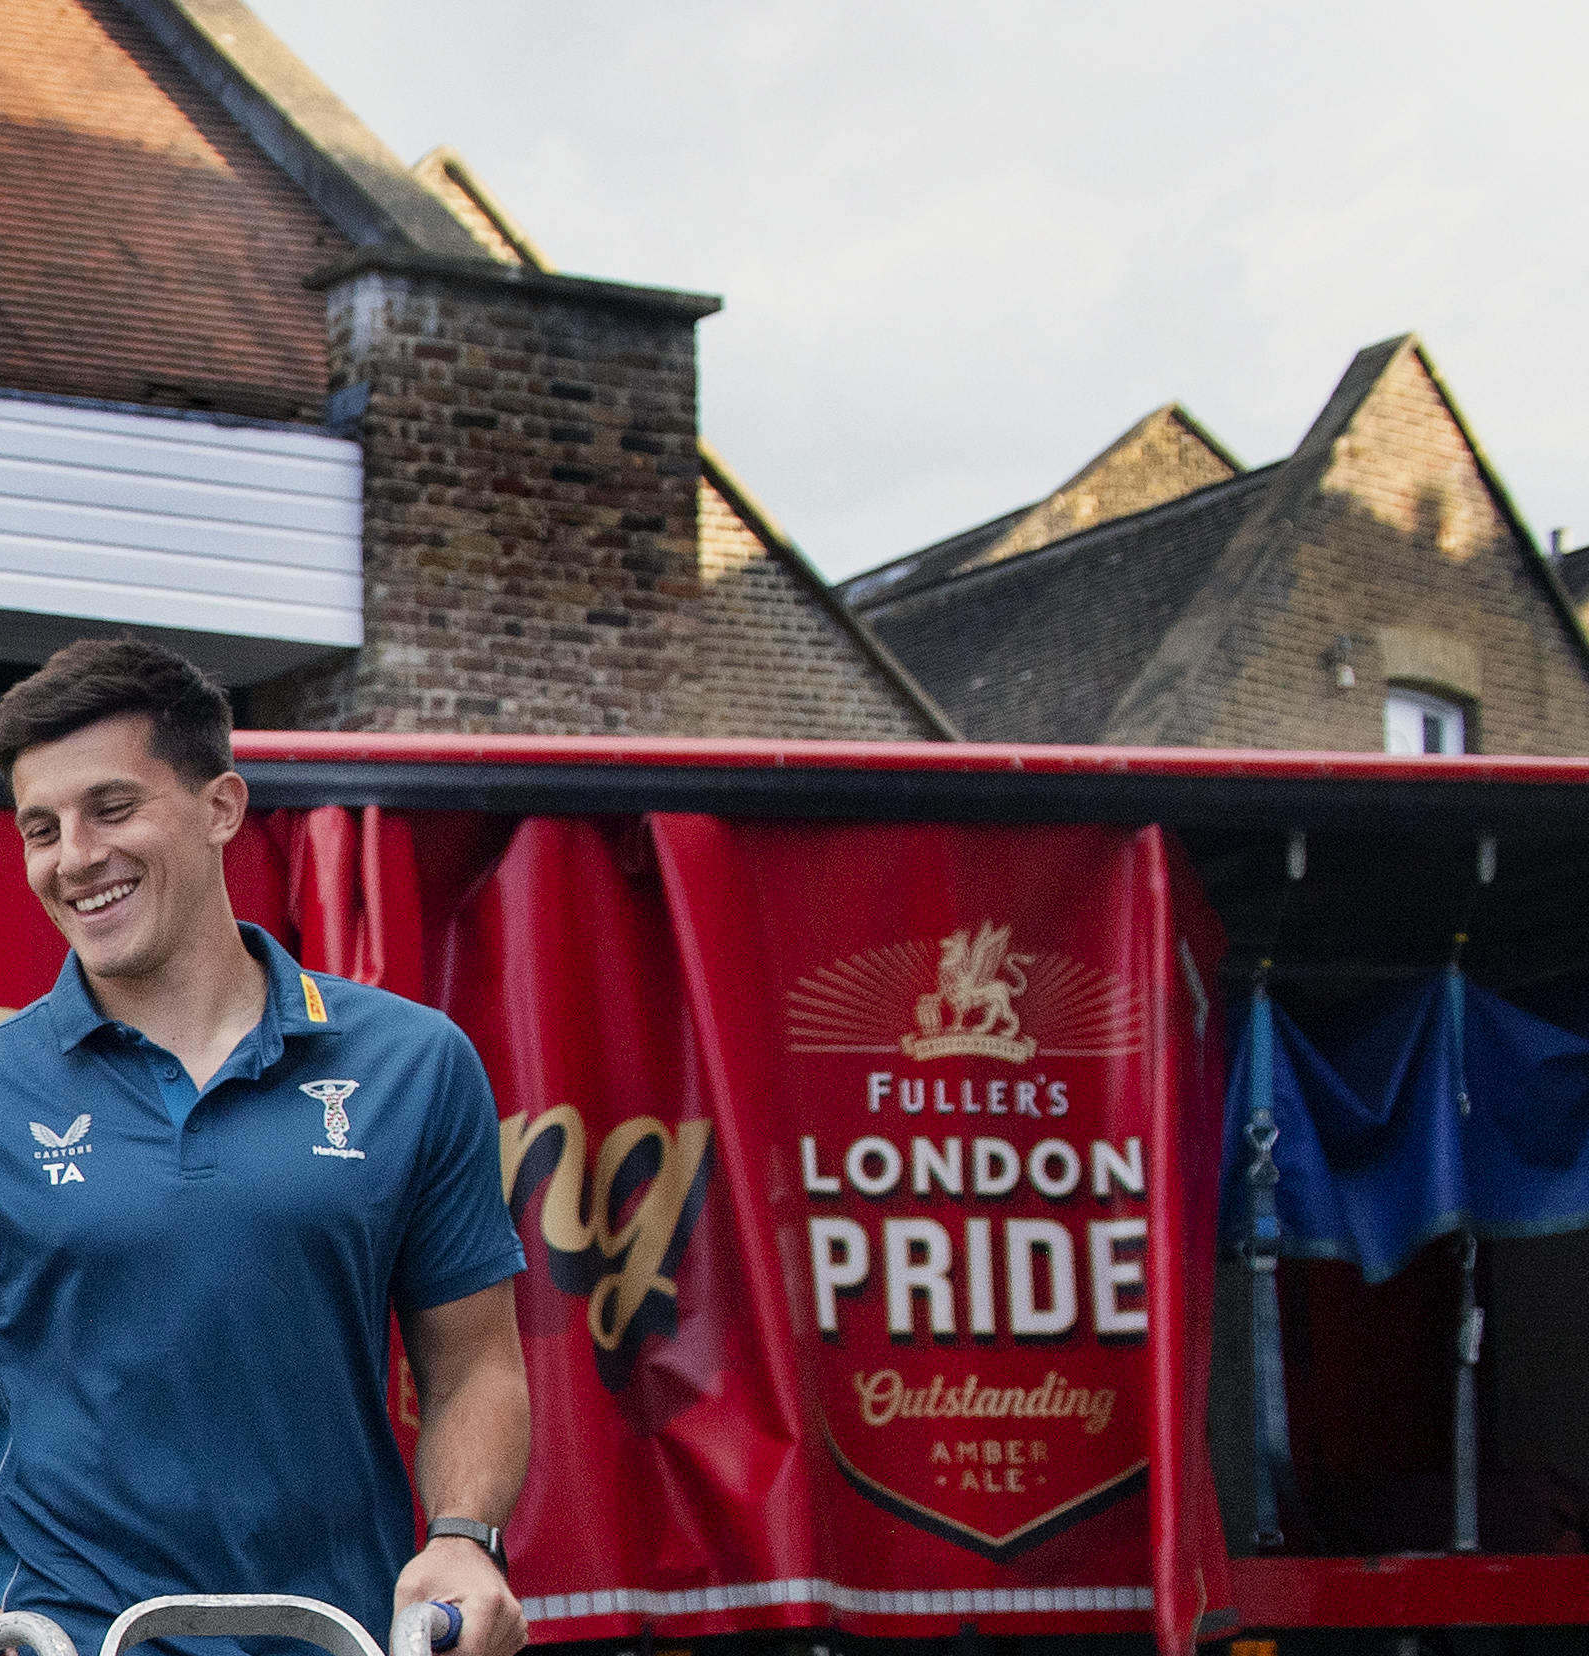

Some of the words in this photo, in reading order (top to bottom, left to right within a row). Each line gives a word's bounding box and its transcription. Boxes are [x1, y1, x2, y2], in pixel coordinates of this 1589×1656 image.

[867, 1070, 1070, 1118] FULLER'S
[33, 1144, 93, 1160] CASTORE
[798, 1135, 1146, 1197] LONDON
[41, 1162, 86, 1186] TA
[806, 1216, 1149, 1339] PRIDE
[853, 1367, 1116, 1435] Outstanding
[930, 1439, 1050, 1466] AMBER
[959, 1467, 1027, 1494] ALE
